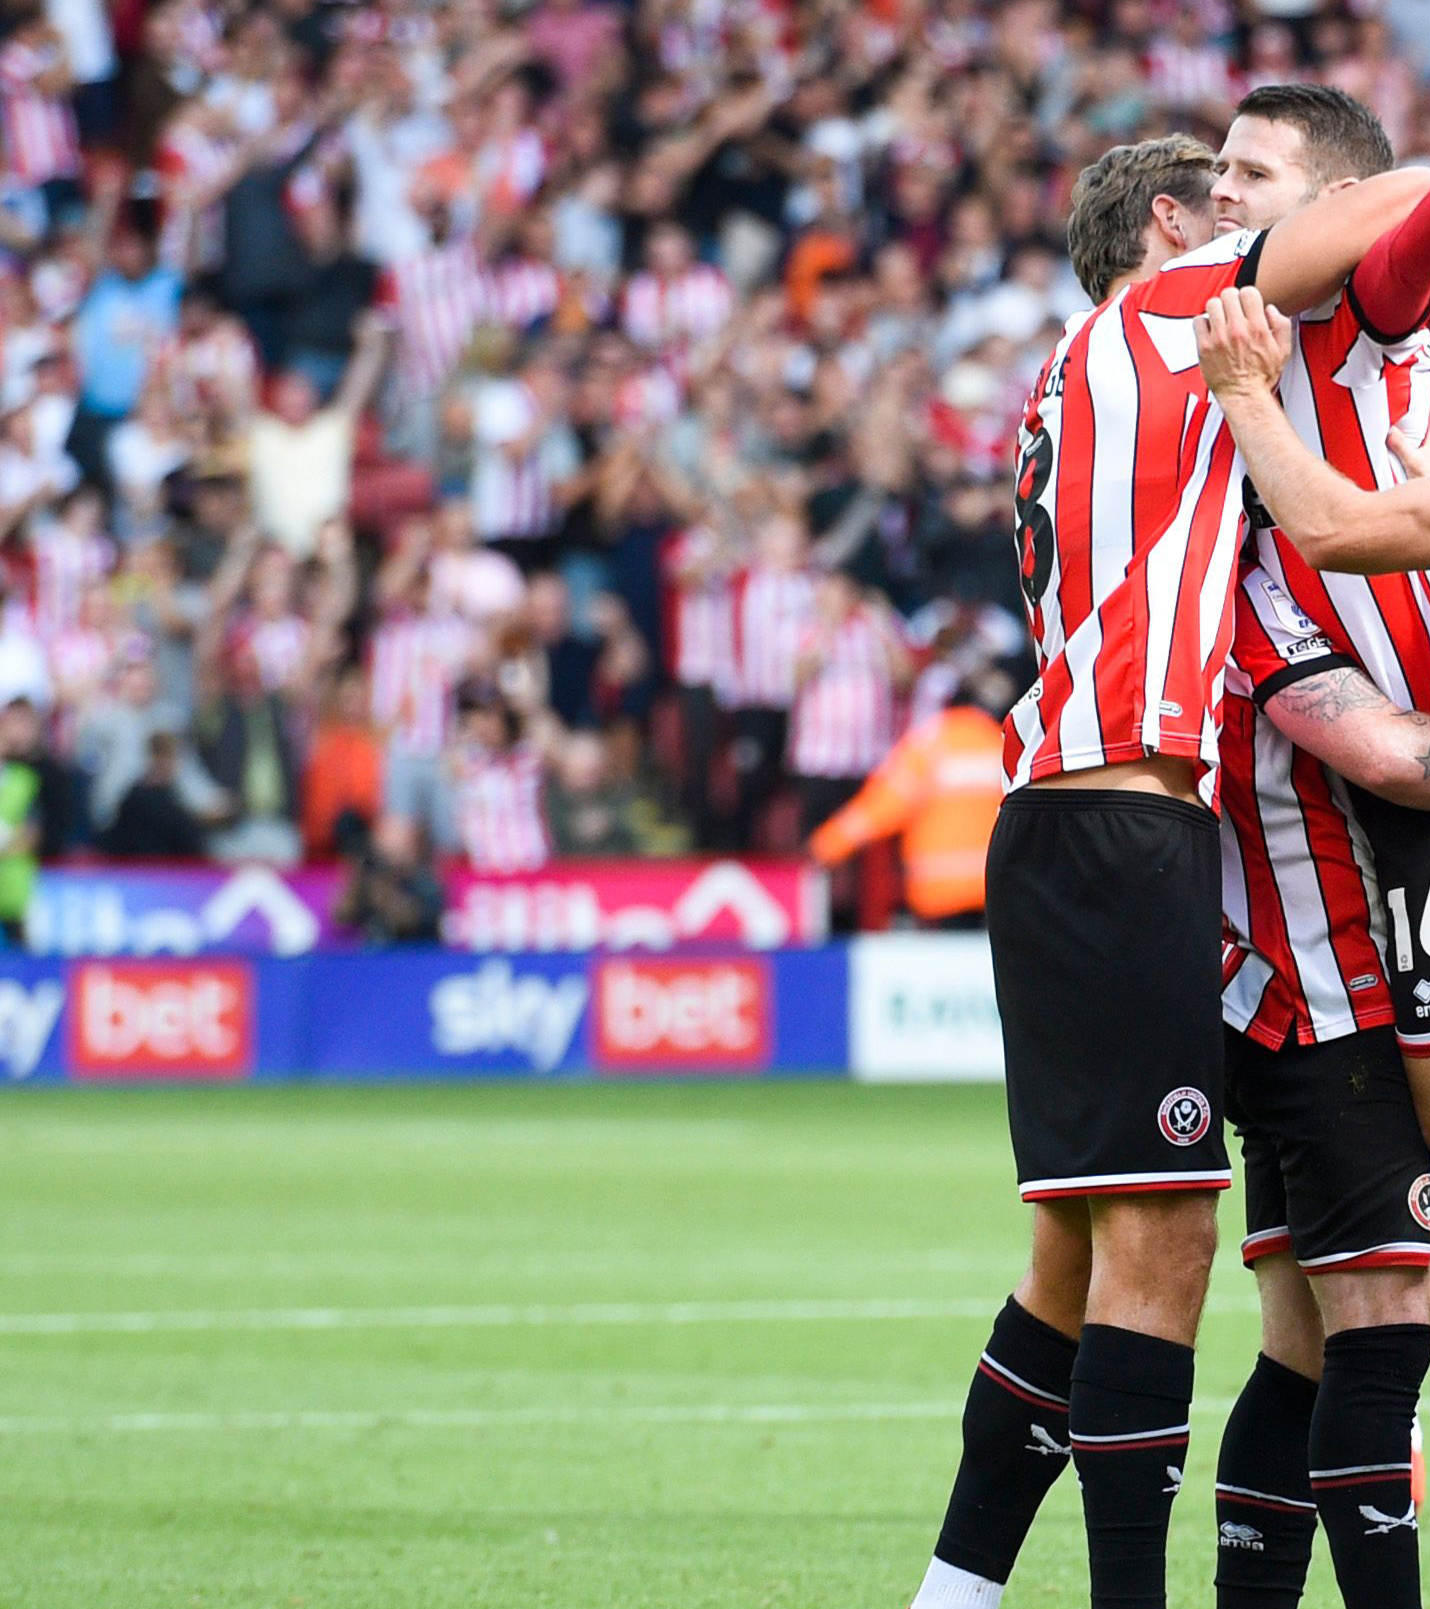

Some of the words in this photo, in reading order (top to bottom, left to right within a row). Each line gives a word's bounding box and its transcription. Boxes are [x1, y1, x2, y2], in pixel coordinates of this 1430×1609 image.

[1015, 427, 1054, 608] 8
[84, 965, 242, 1058] bet
[430, 958, 587, 1073] sky
[602, 962, 758, 1050] bet
